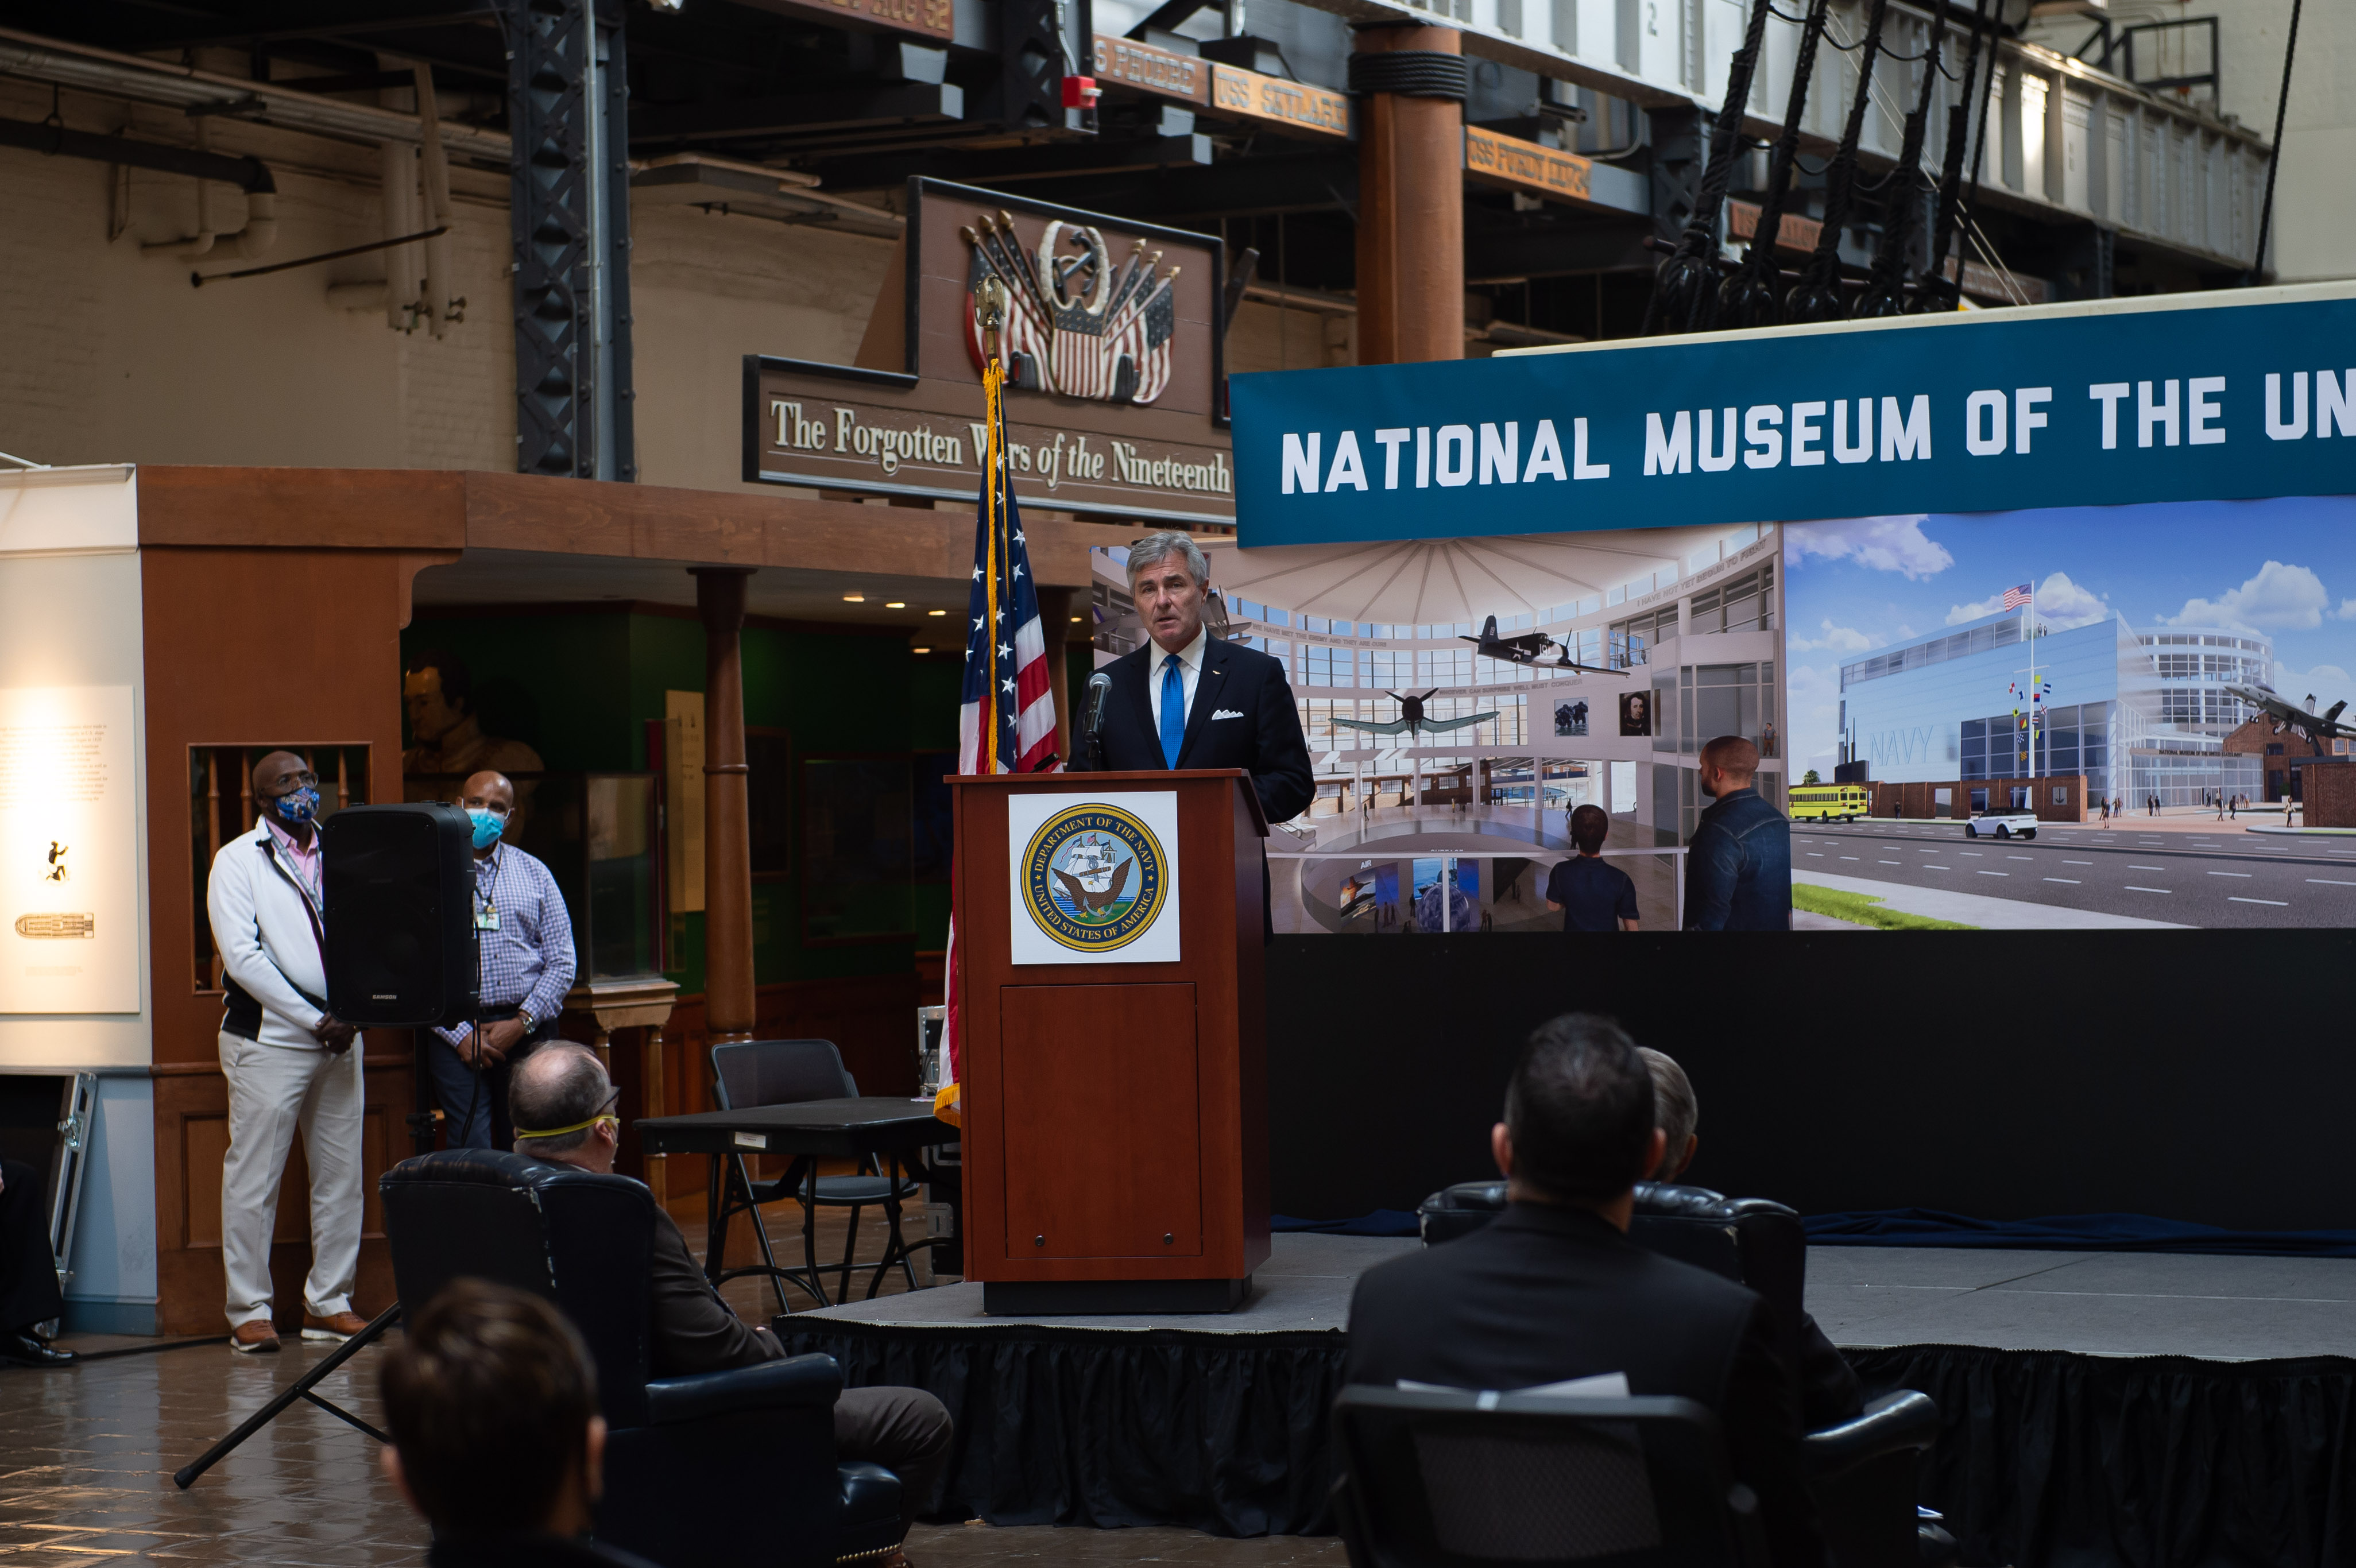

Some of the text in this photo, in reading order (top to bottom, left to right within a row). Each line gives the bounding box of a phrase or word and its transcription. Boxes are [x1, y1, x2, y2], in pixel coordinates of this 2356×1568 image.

[1647, 2, 1658, 37] 2
[1112, 45, 1196, 95] PHOEBE
[1216, 71, 1250, 108] USS
[771, 400, 1232, 494] The Forgotten Wrs of the Nineteenth
[1281, 368, 2356, 495] NATIONAL MUSEUM OF THE UN
[1642, 593, 1661, 606] HAVE
[1663, 585, 1678, 598] NOT
[1680, 577, 1695, 591] YET
[1726, 556, 1738, 568] TO
[1263, 625, 1280, 635] HAVE
[1295, 632, 1307, 640] THE
[1551, 676, 1583, 688] CONQUER
[1870, 725, 1933, 766] NAVY
[1035, 817, 1154, 872] DEPARTMENT OF THE NAVY
[1360, 860, 1372, 869] AIR
[1035, 885, 1154, 939] UNITED STATES OF AMERICA
